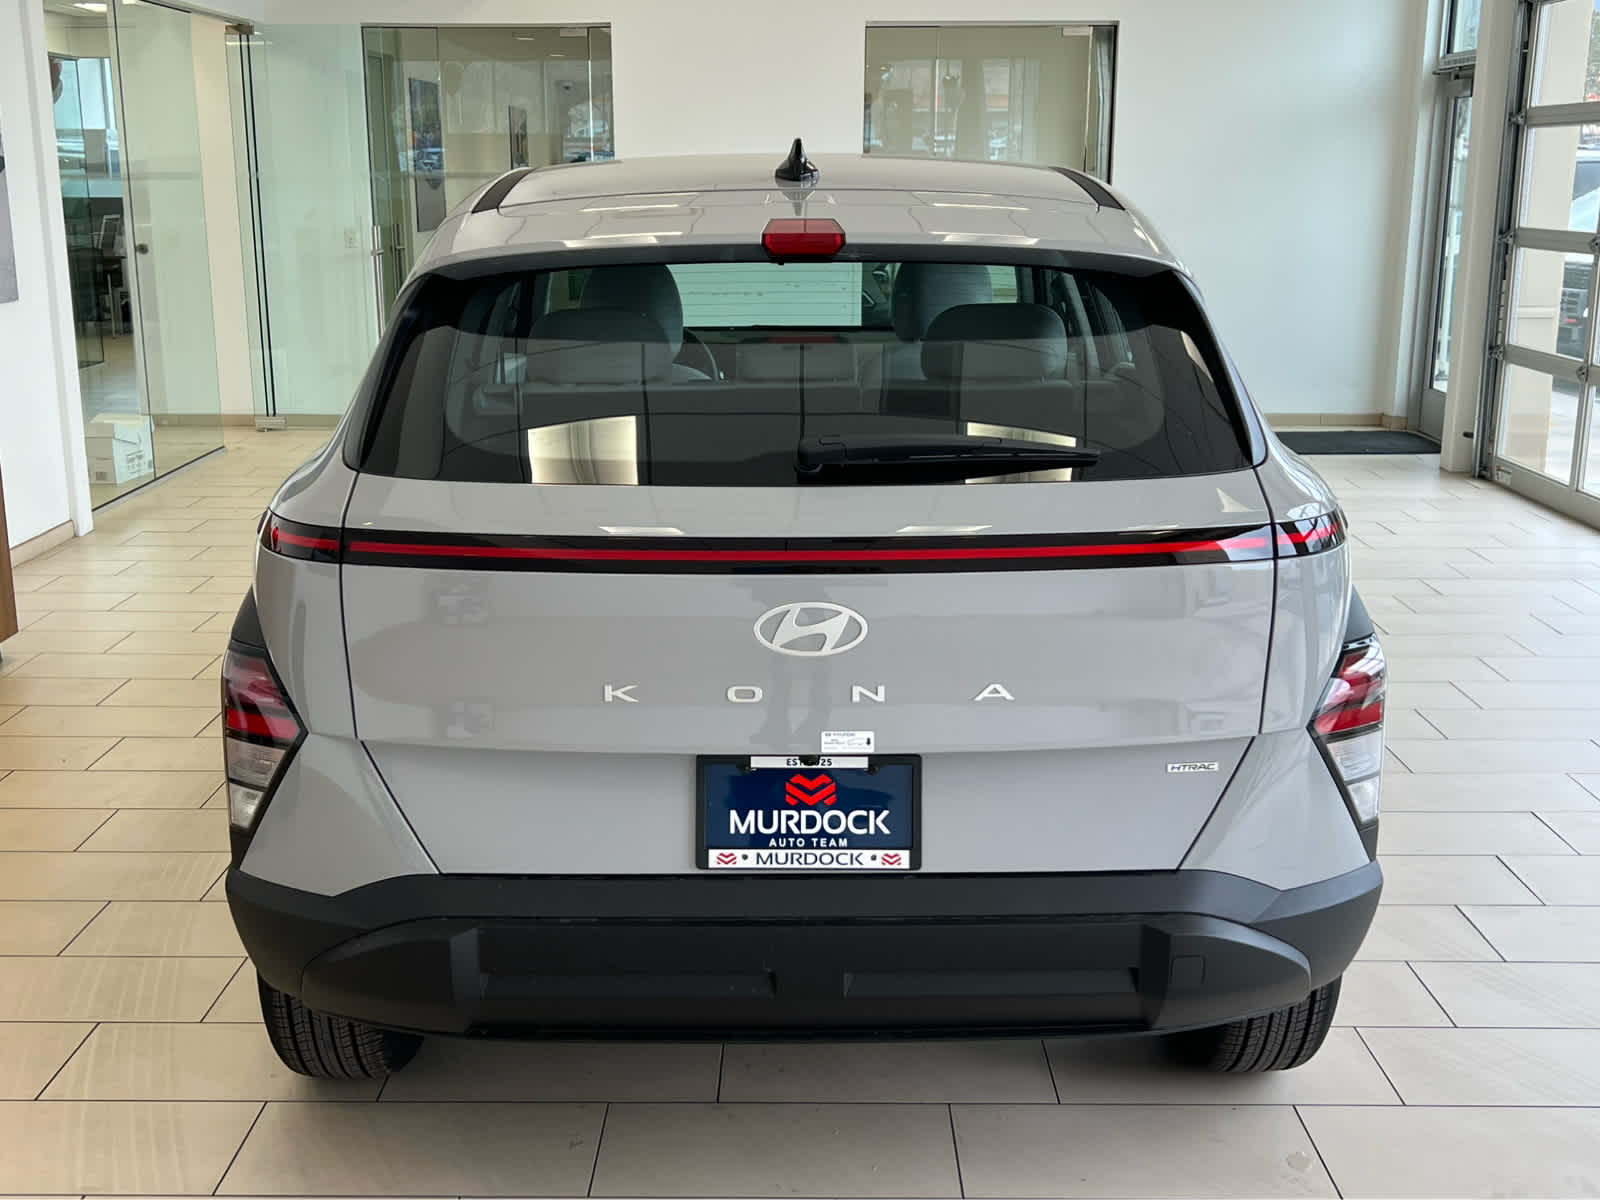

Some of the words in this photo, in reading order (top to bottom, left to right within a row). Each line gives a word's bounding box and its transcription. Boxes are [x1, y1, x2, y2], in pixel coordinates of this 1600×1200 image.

[604, 683, 1015, 702] KONA
[1170, 763, 1217, 771] HTRAC
[729, 809, 891, 835] MURDOCK
[768, 838, 805, 848] AUTO
[811, 838, 848, 848] TEAM
[756, 852, 864, 866] MURDOCK
